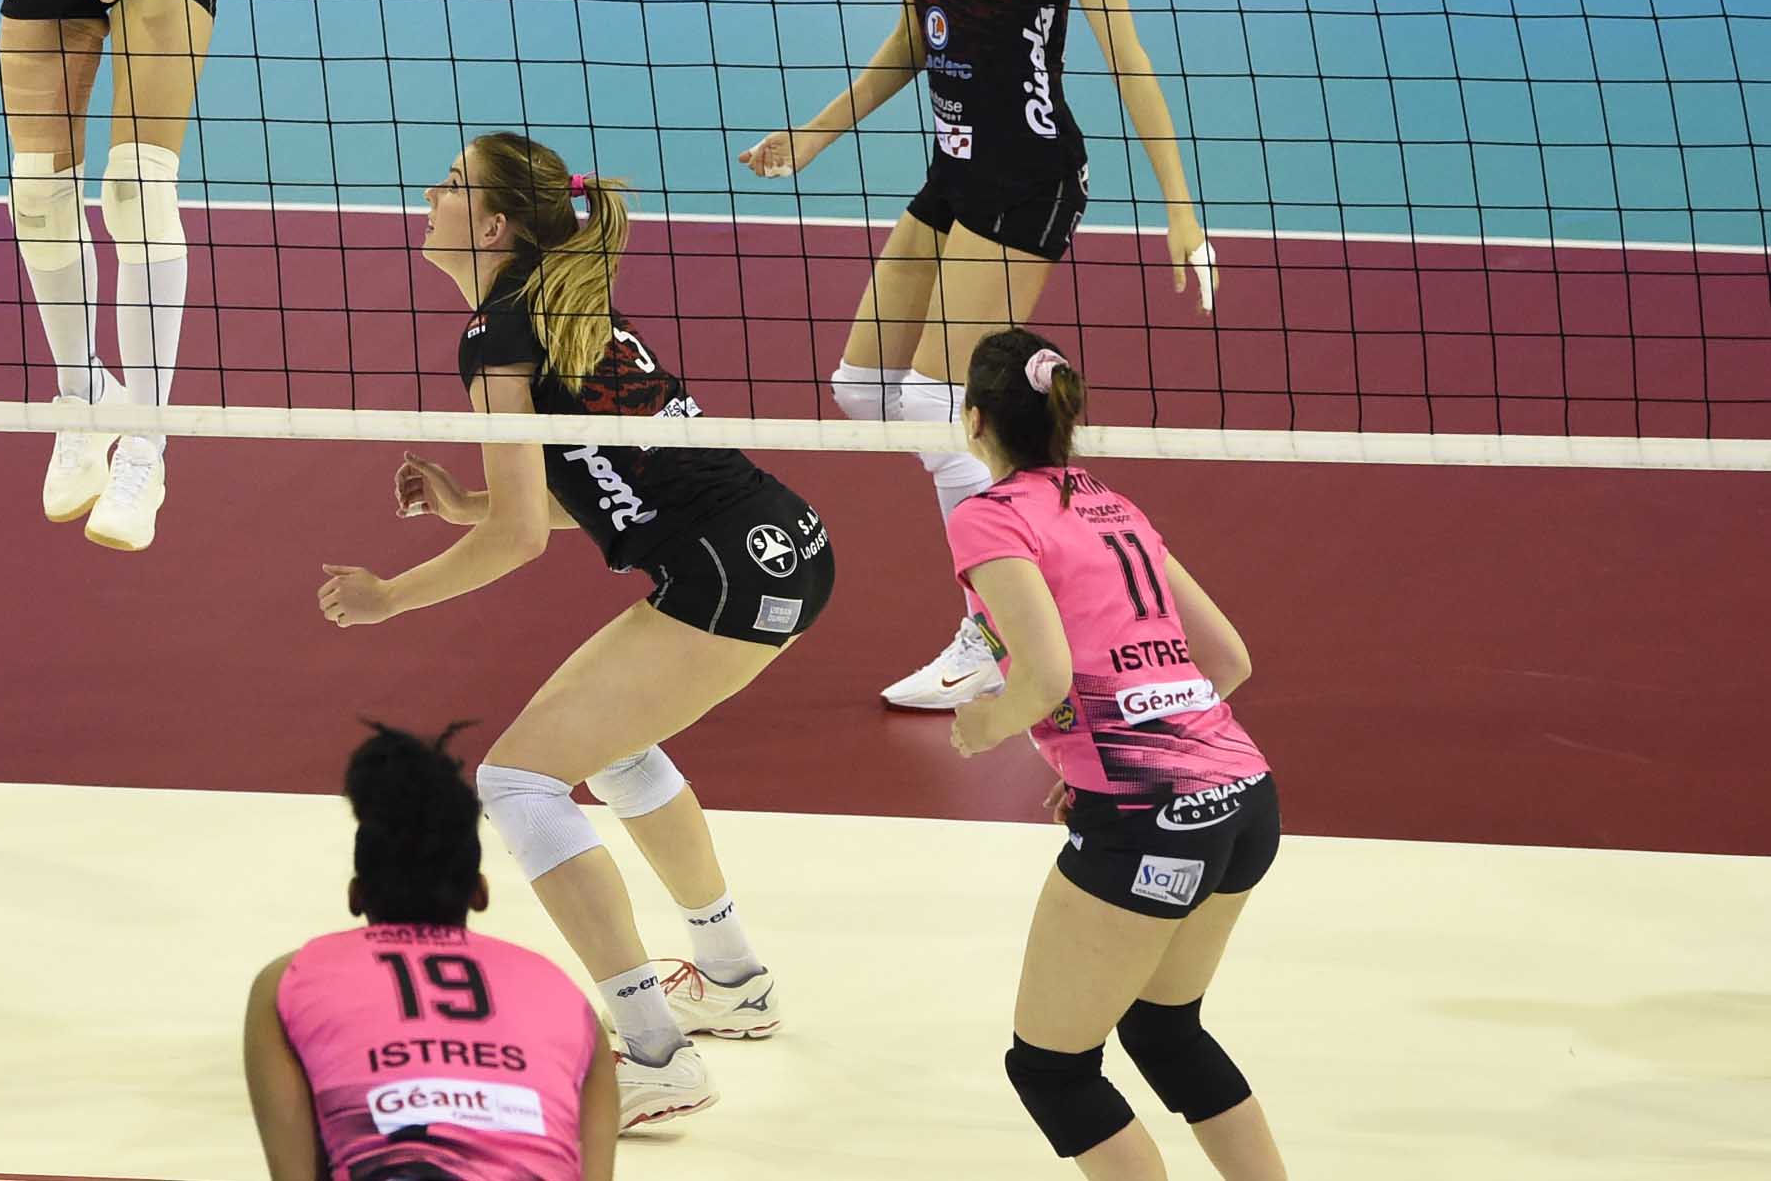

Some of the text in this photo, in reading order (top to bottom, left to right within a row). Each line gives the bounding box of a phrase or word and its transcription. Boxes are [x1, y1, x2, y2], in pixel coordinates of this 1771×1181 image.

[1098, 530, 1168, 621] 11
[1109, 639, 1190, 674] ISTRE
[1123, 686, 1194, 715] Géant
[1172, 772, 1267, 812] ARIAN
[1172, 798, 1241, 823] HOTEL
[372, 951, 496, 1022] 19
[368, 1039, 527, 1073] ISTRES
[376, 1085, 490, 1114] Géant
